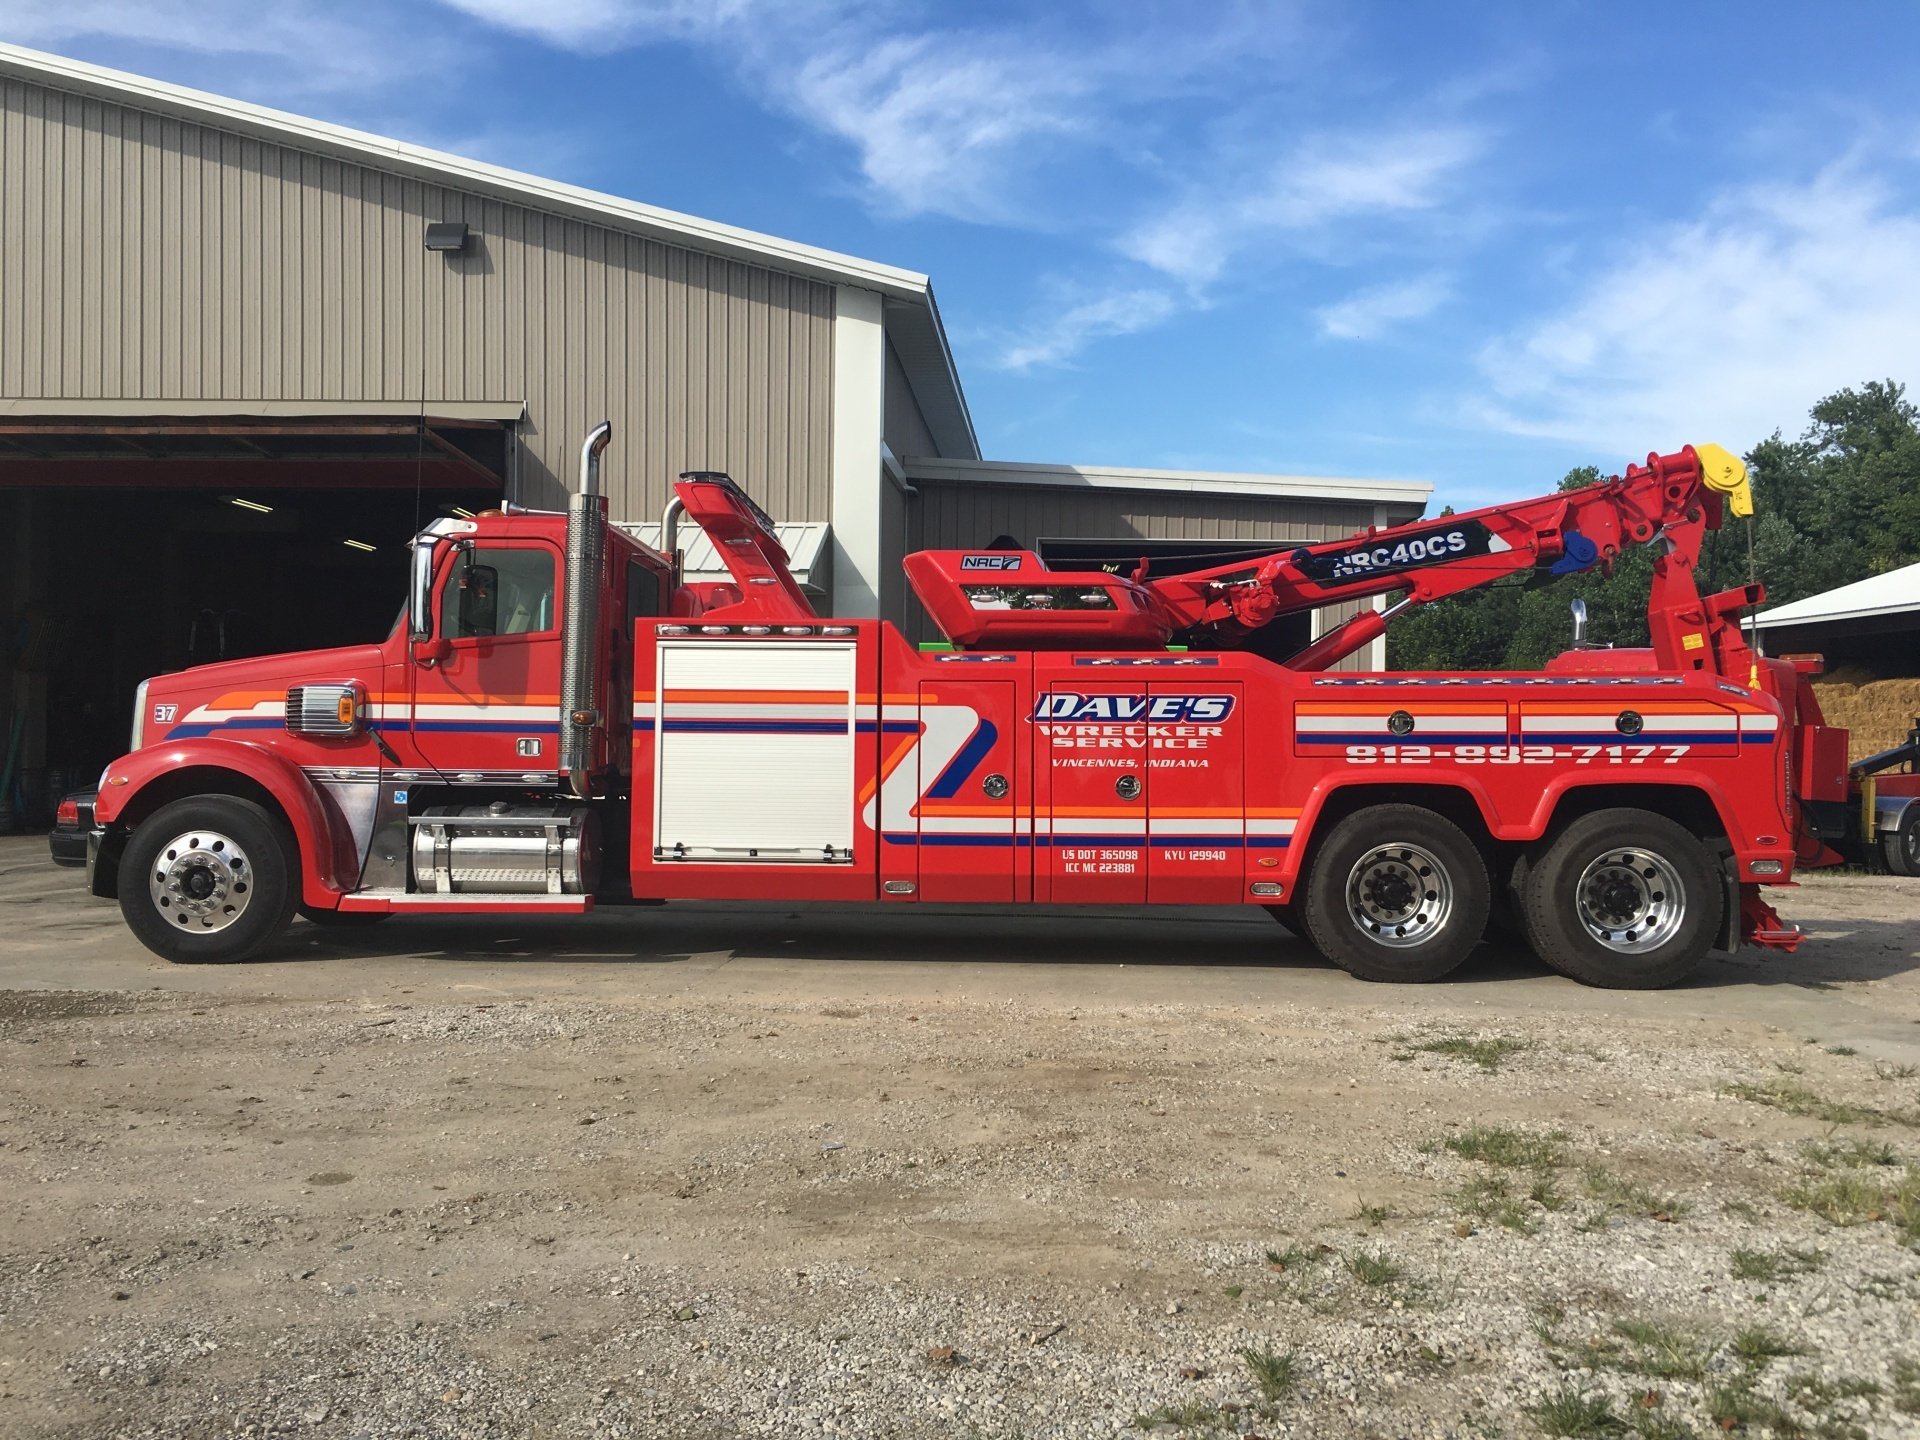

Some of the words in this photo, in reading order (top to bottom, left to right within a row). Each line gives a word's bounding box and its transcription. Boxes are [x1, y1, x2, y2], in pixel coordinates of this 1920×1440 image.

[1333, 531, 1467, 578] NRC40CS
[964, 557, 1002, 568] NRC
[1033, 693, 1231, 721] DAVE'S
[154, 705, 178, 723] 37
[1038, 725, 1223, 737] WRECKER
[1052, 737, 1208, 749] SERVICE
[1346, 745, 1690, 764] 812-882-7177
[1052, 758, 1139, 768] VINCENNES,
[1144, 759, 1209, 768] INDIANA
[1062, 849, 1075, 860] US
[1077, 849, 1097, 860] DOT
[1099, 849, 1138, 860] 365098
[1164, 850, 1186, 861] KYU
[1189, 850, 1226, 861] 129940
[1065, 862, 1079, 873] ICC
[1082, 862, 1097, 873] MC
[1099, 862, 1135, 873] 223881
